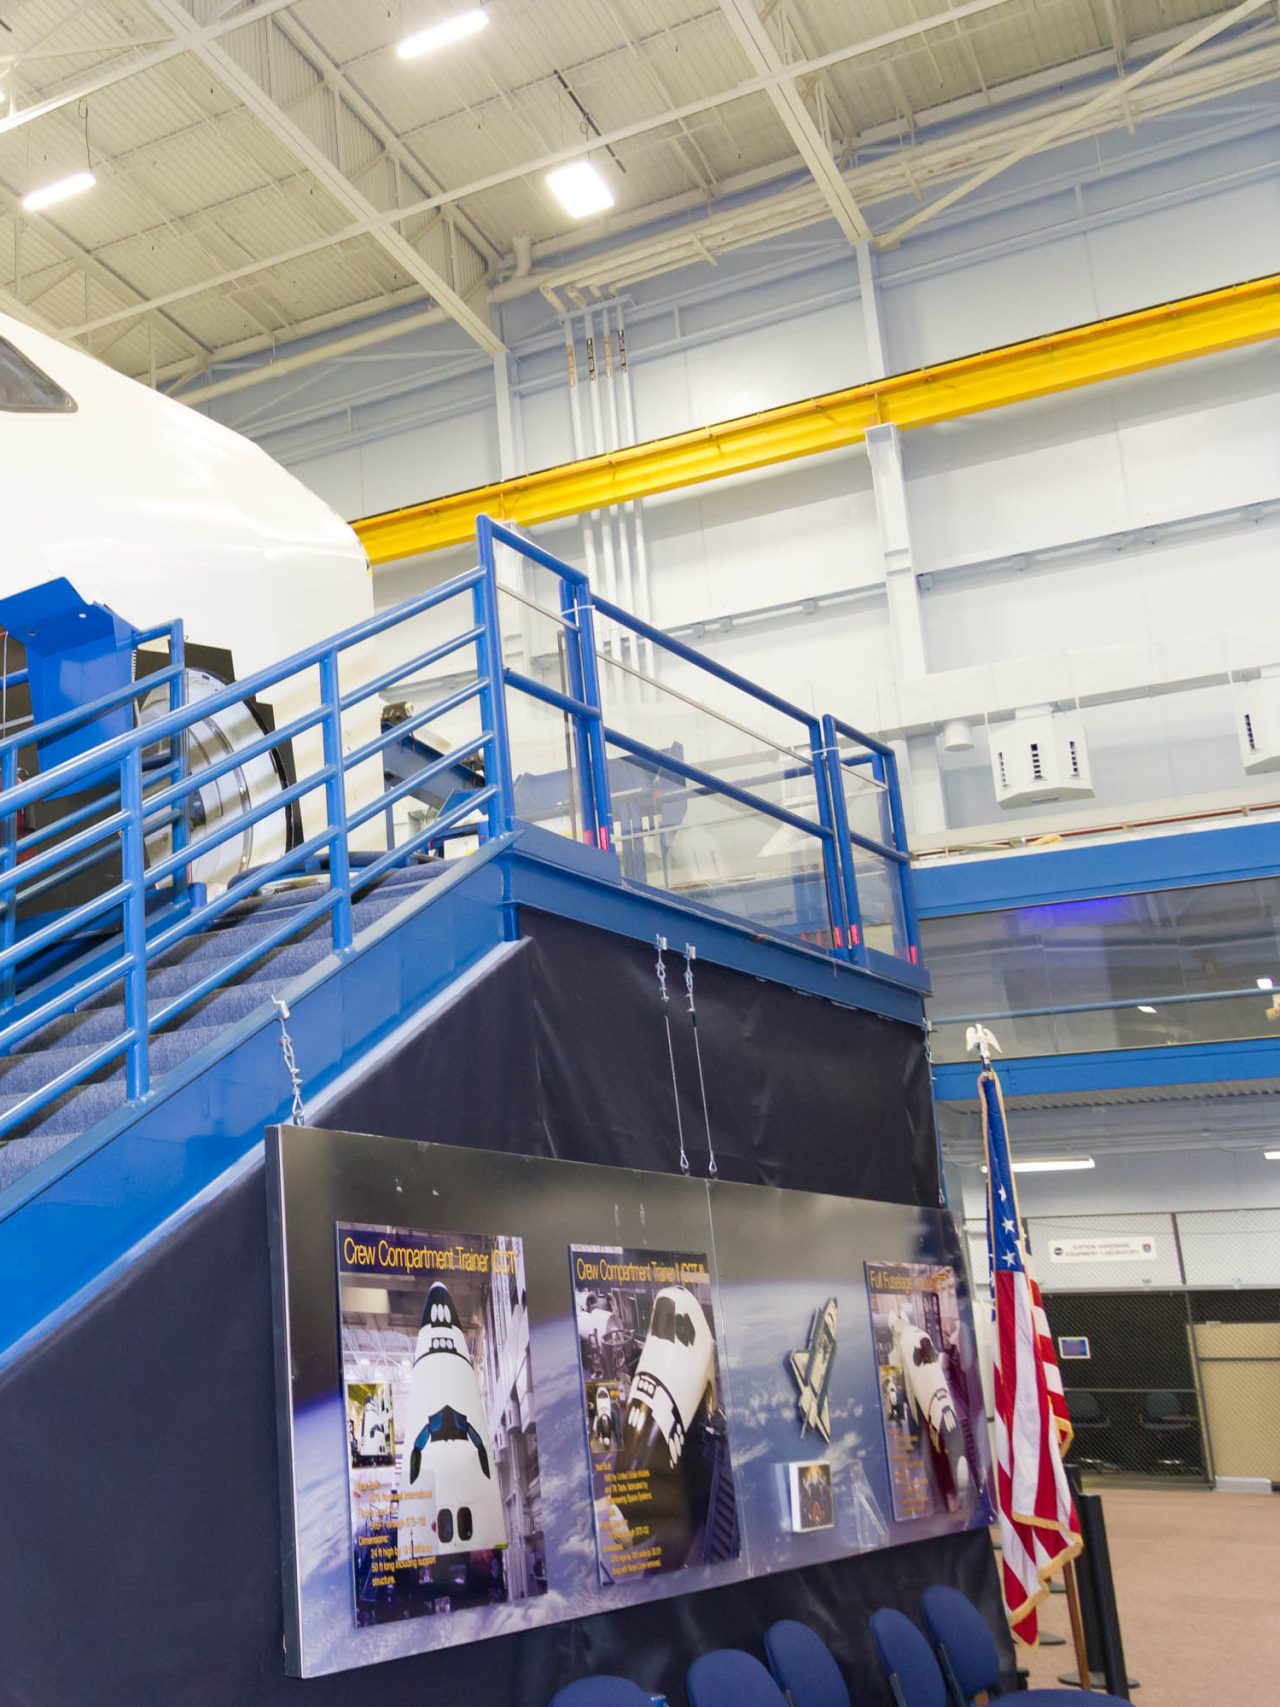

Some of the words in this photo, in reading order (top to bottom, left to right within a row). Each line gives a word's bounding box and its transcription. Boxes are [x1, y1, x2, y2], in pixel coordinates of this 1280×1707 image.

[343, 1237, 375, 1265] Crew
[378, 1239, 454, 1273] Compartment
[456, 1246, 489, 1273] Trainer
[576, 1258, 598, 1280] Crew
[600, 1259, 651, 1284] Compartment
[651, 1261, 674, 1282] Trainer
